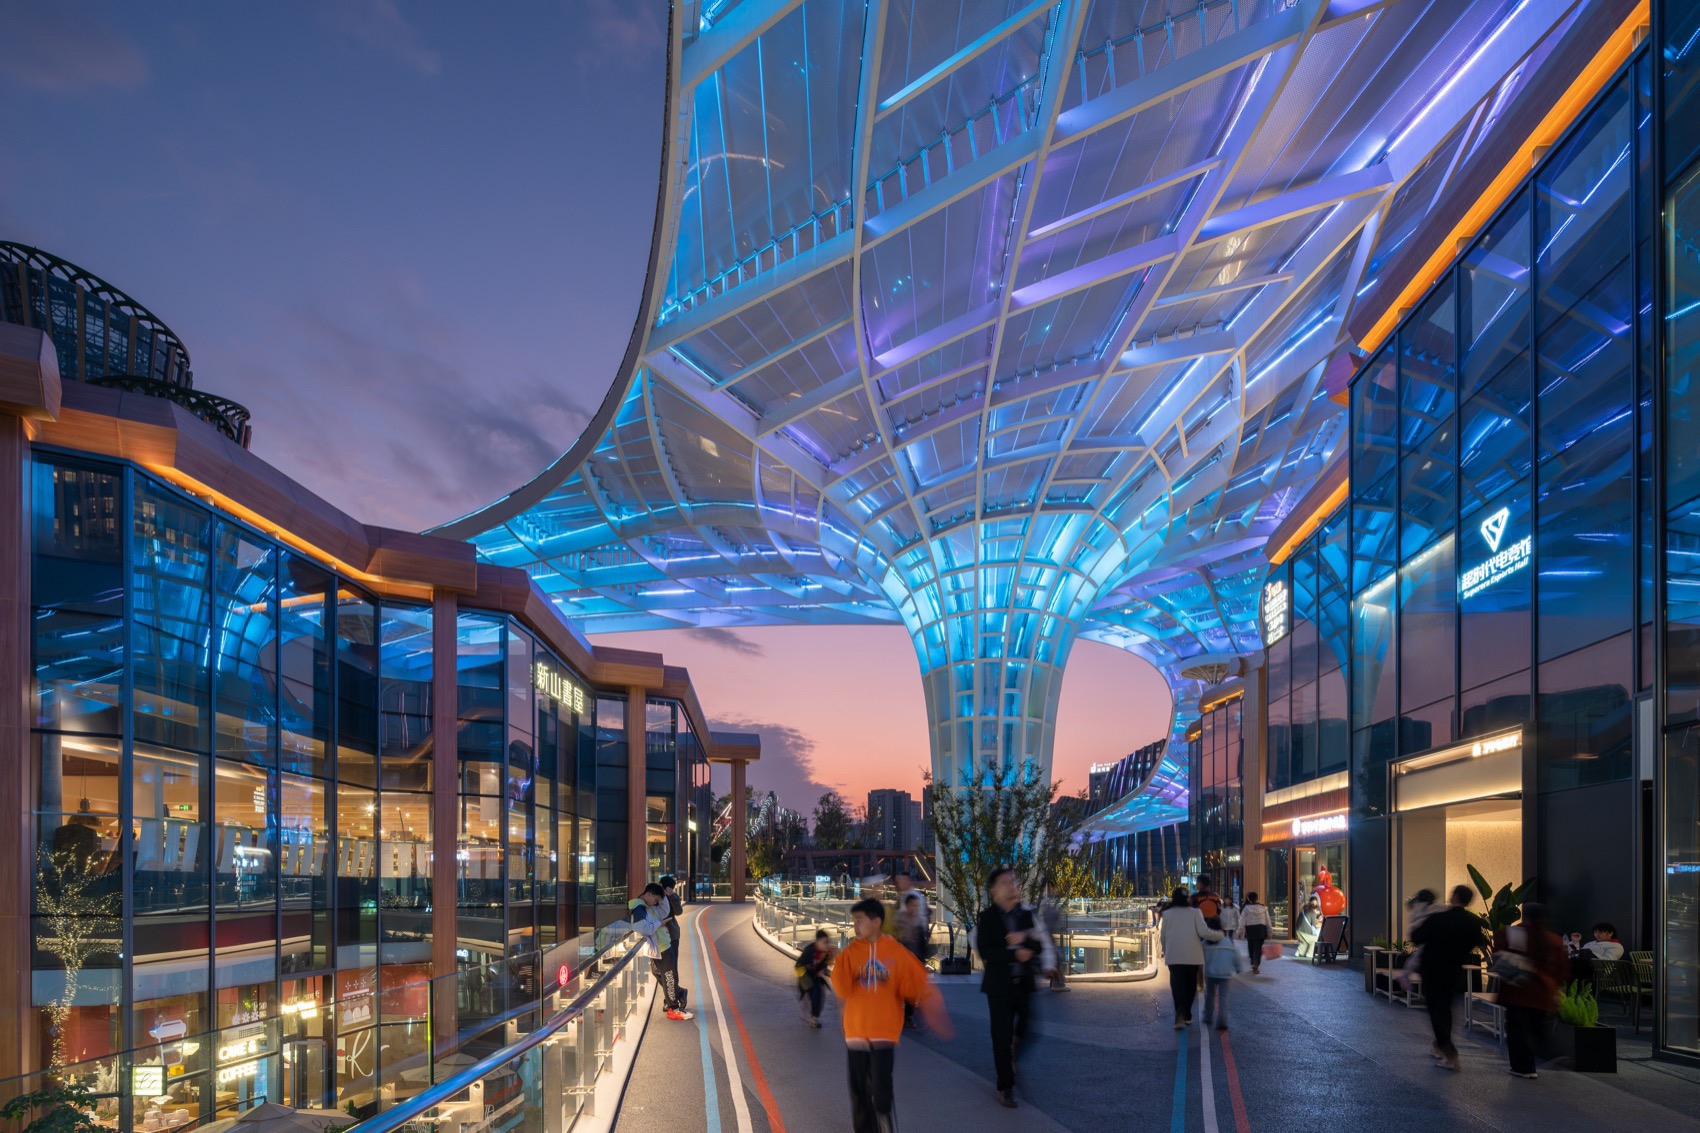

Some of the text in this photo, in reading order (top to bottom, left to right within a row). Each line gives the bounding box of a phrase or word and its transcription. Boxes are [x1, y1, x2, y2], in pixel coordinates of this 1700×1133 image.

[1462, 535, 1532, 592] 超时代电竞馆
[1463, 556, 1529, 600] Superera Esports Hall
[536, 661, 584, 714] 新山書屋
[219, 1042, 248, 1061] CAKE
[219, 1060, 258, 1083] COFFEE
